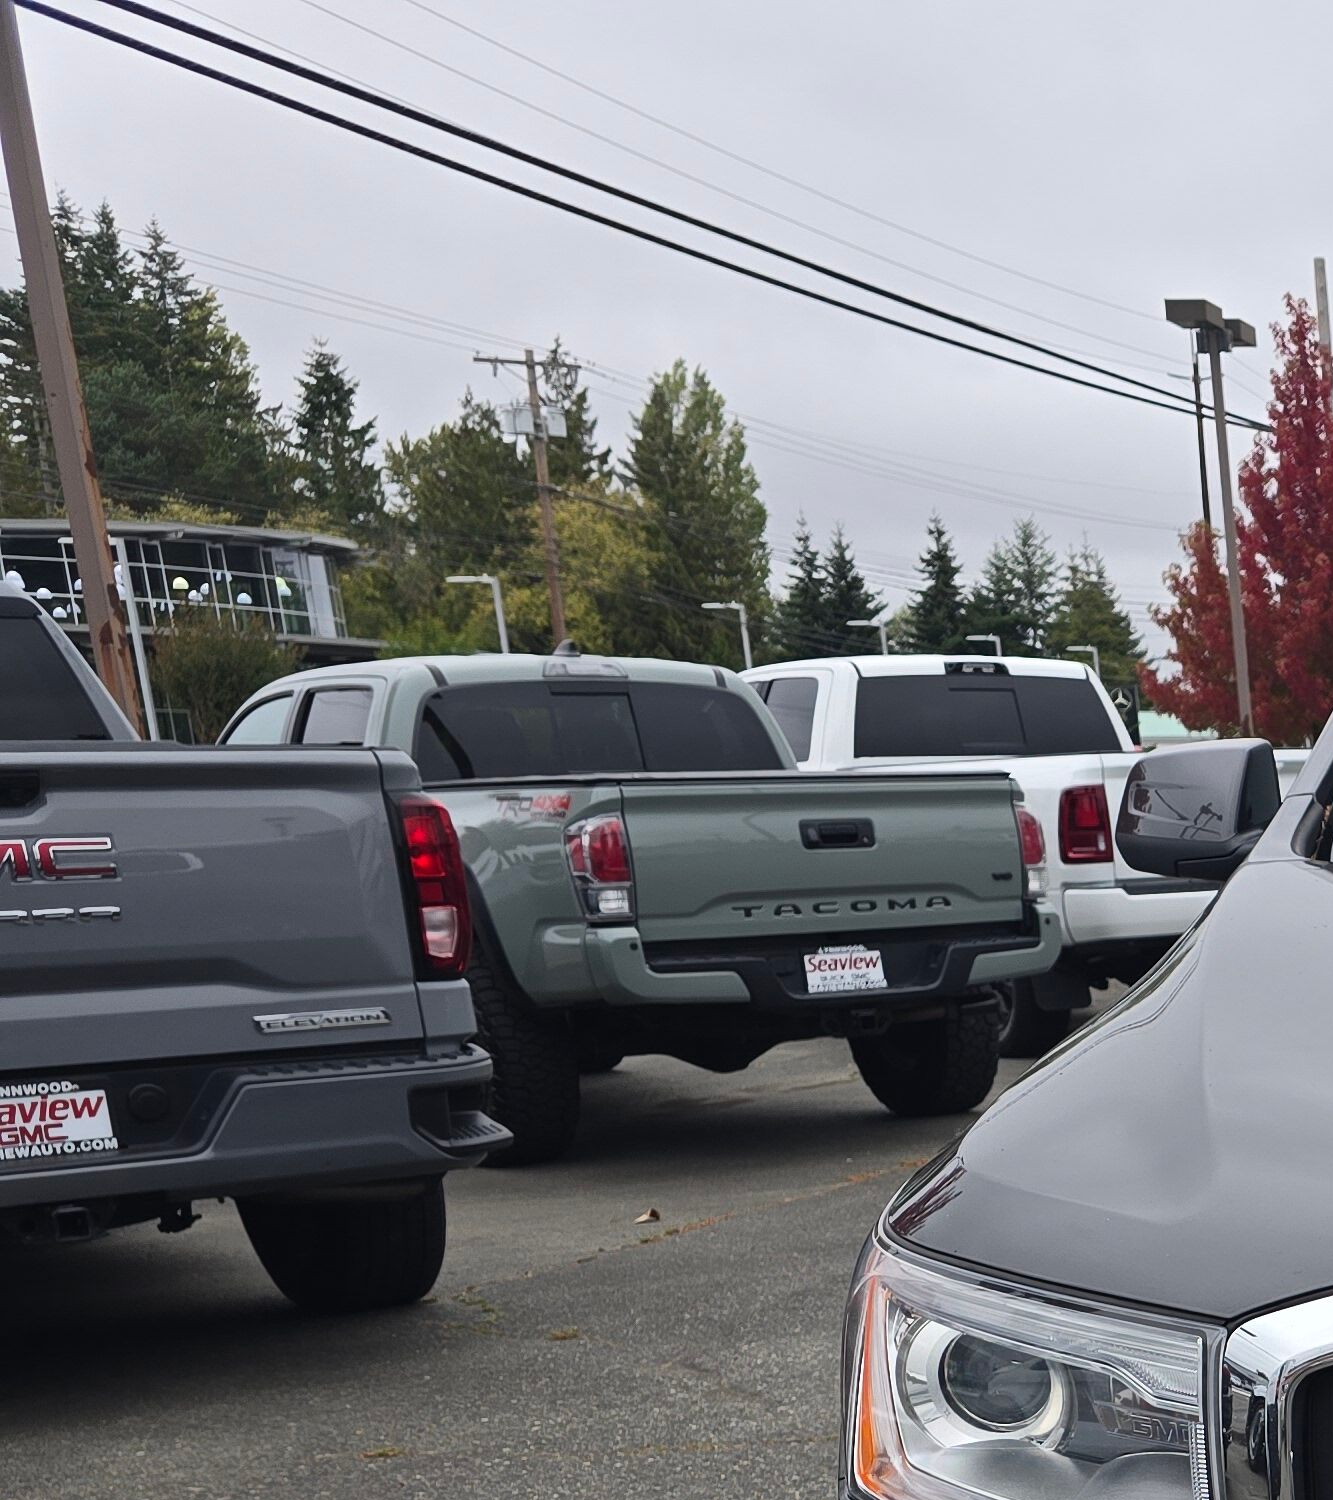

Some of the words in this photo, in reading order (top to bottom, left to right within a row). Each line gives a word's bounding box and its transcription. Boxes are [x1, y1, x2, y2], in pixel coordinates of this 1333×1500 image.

[731, 896, 952, 918] TACOMA
[807, 953, 880, 973] Seaview
[265, 1013, 381, 1030] ELEVATION
[0, 1081, 73, 1097] NNWOOD
[0, 1094, 104, 1125] aview
[0, 1123, 68, 1146] GMC
[0, 1137, 118, 1160] IEWAUTO.COM
